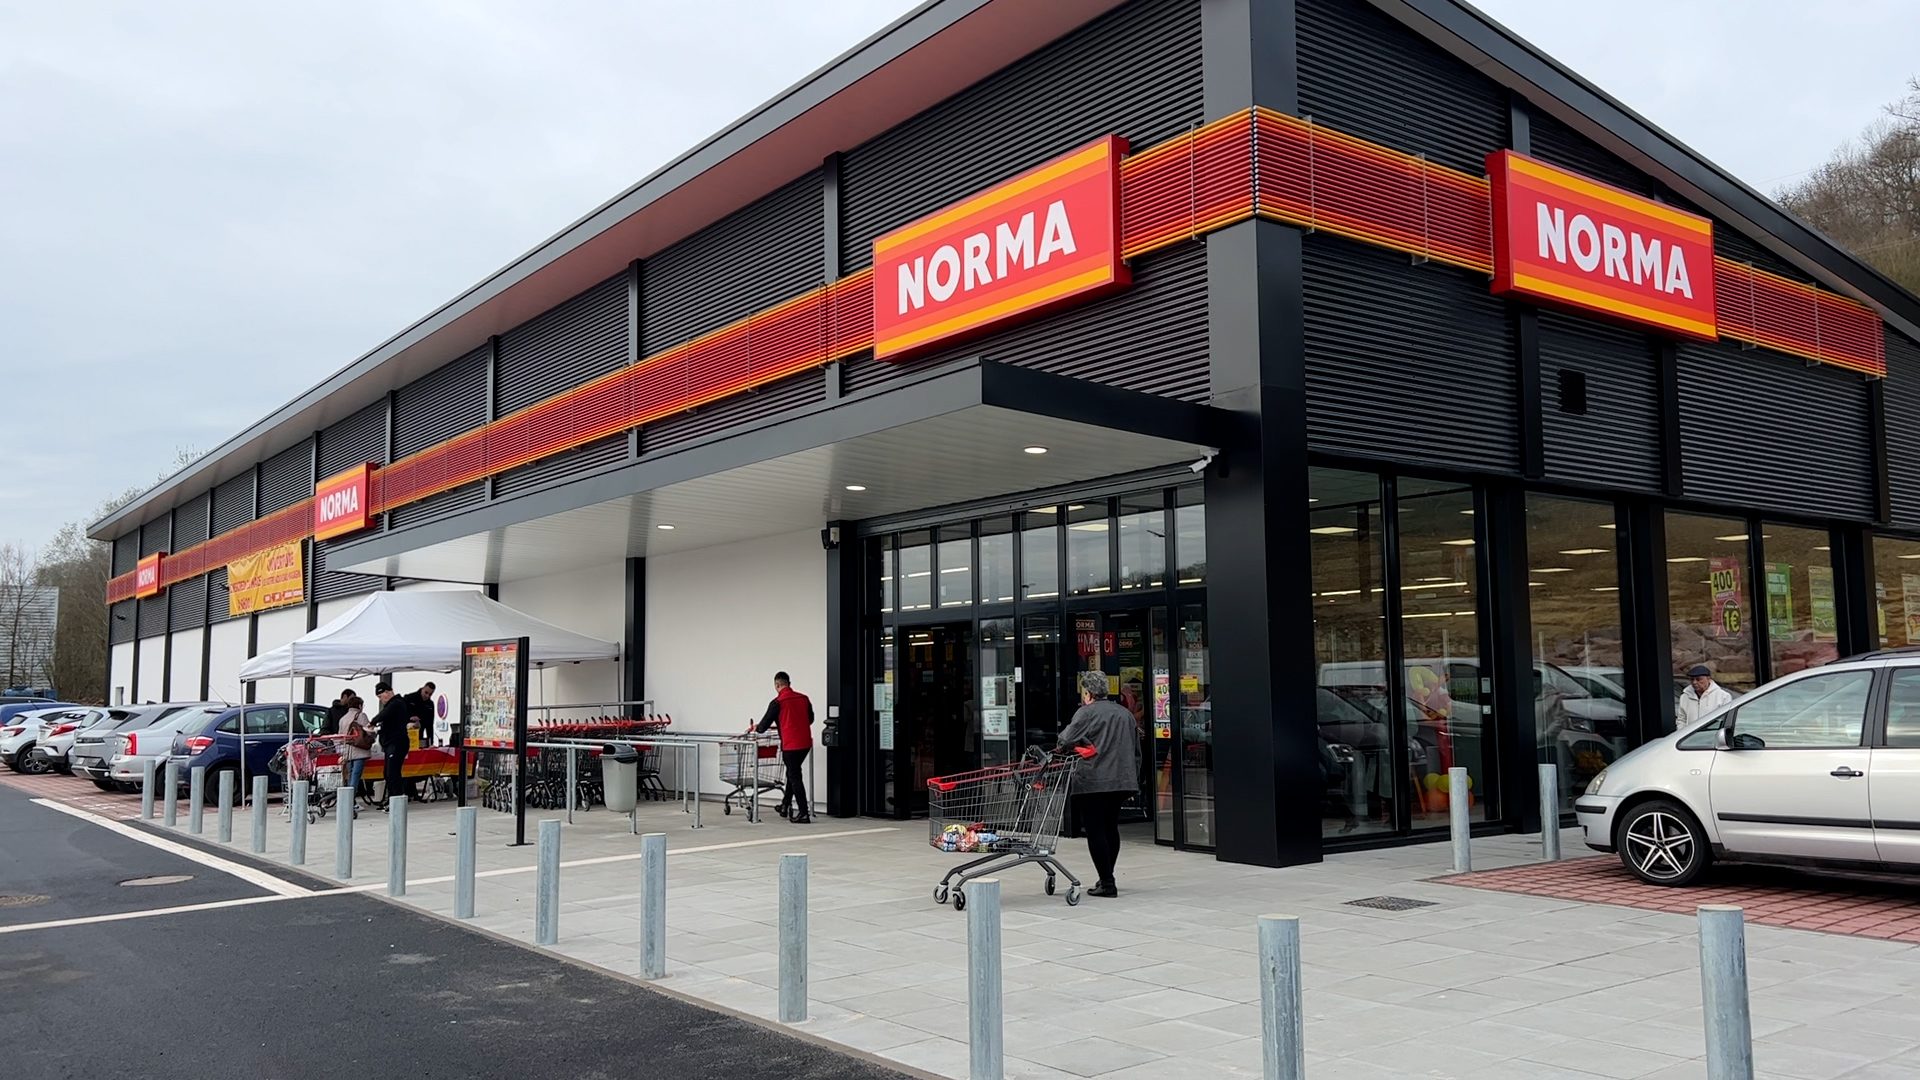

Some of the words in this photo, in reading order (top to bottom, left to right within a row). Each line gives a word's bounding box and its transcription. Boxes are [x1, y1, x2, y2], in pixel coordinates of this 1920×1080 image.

[897, 199, 1077, 315] NORMA
[1535, 202, 1694, 300] NORMA
[319, 485, 359, 523] NORMA
[138, 565, 155, 588] NORMA
[1713, 570, 1733, 591] 400
[1723, 609, 1740, 633] 1€
